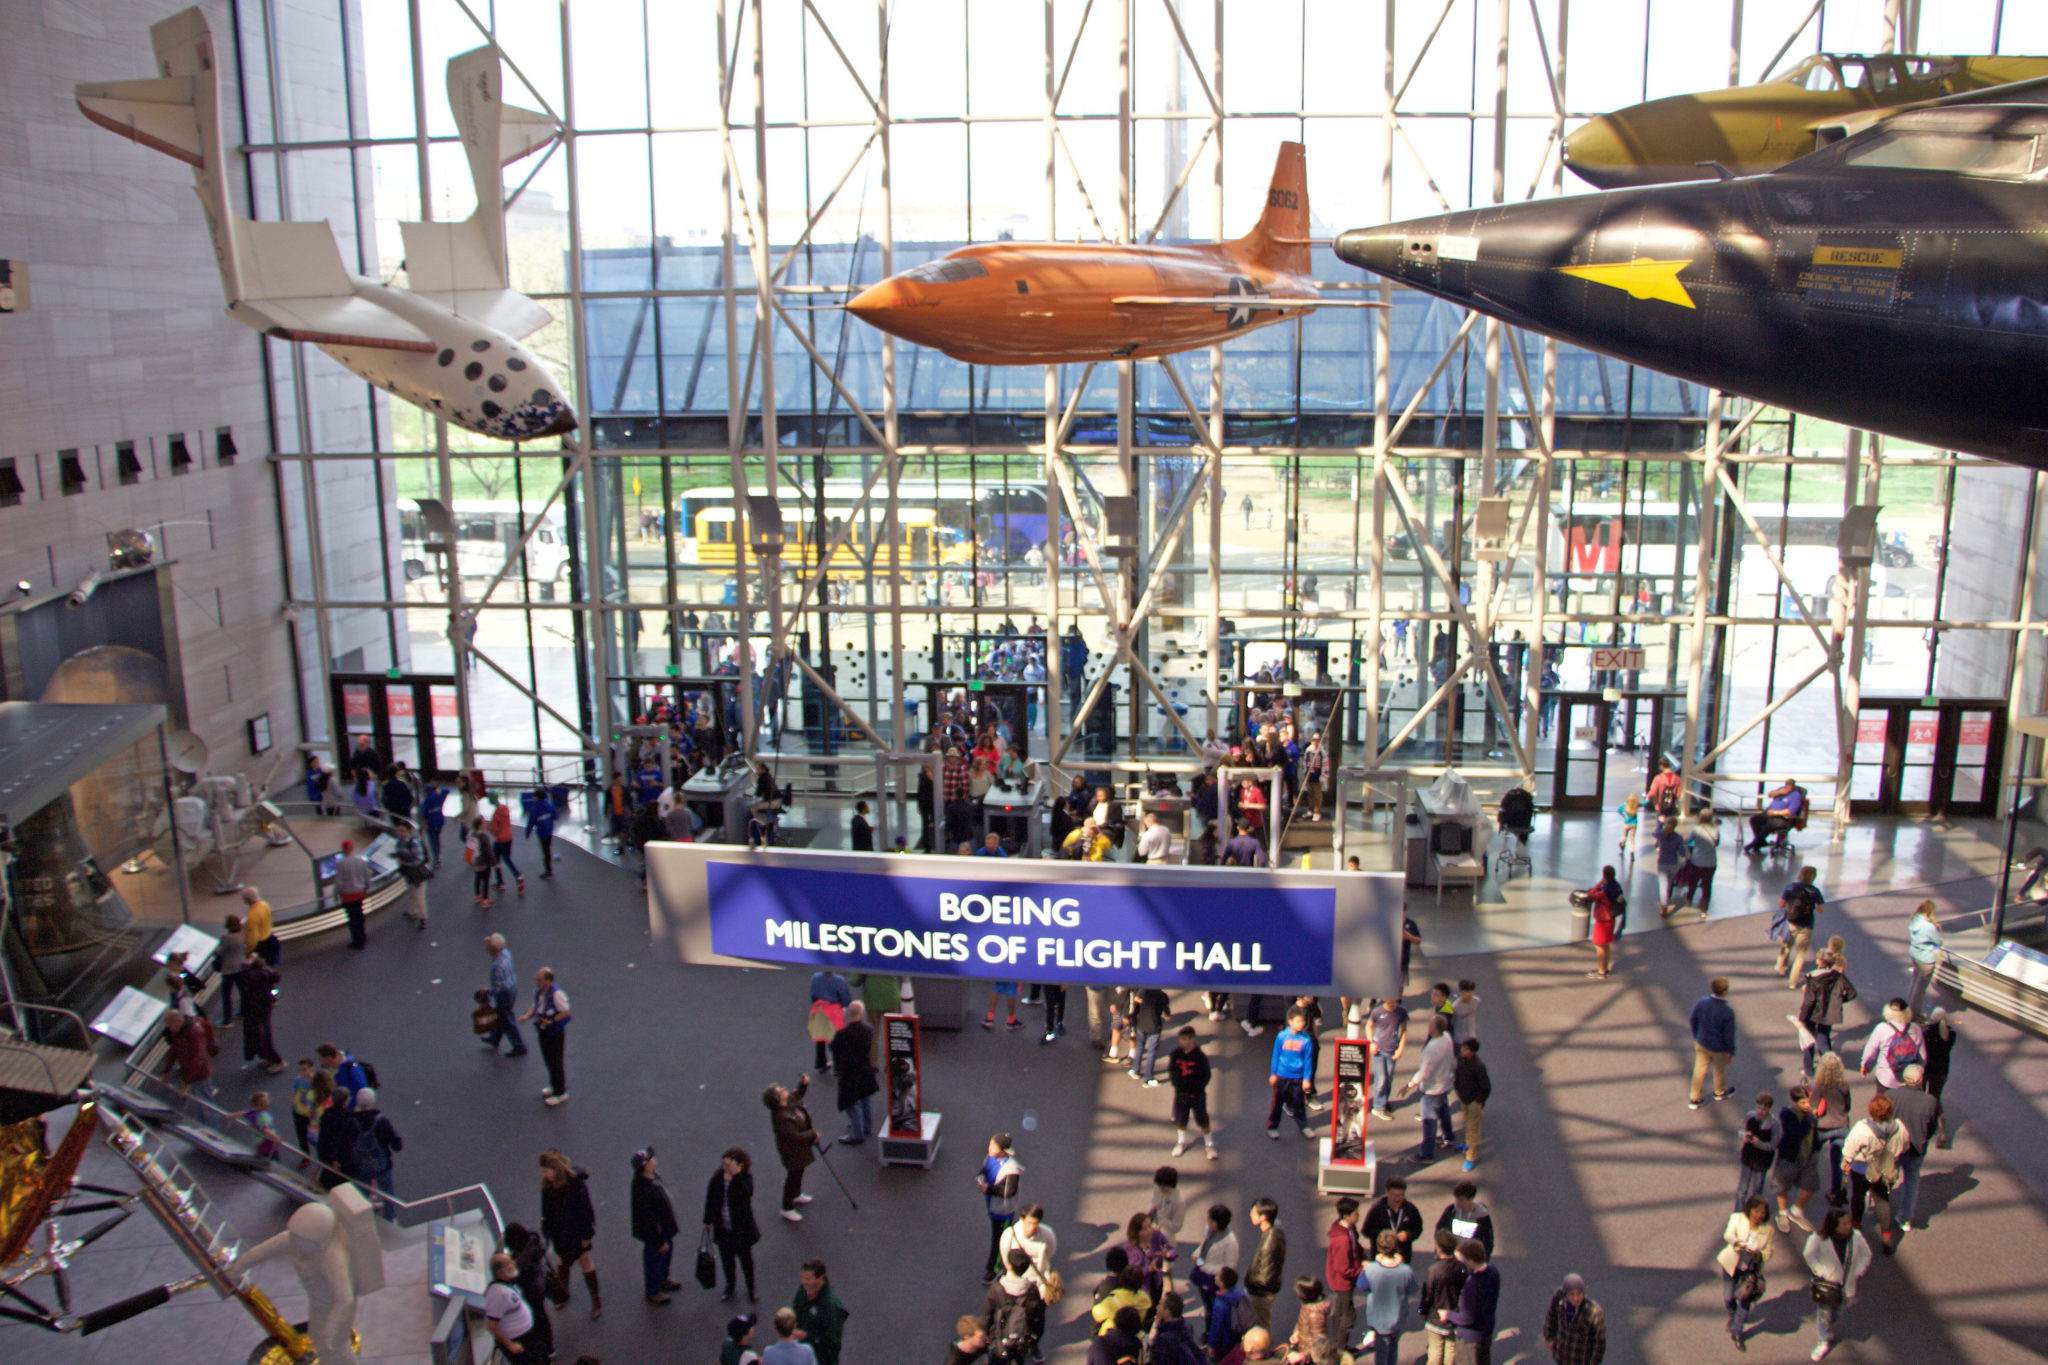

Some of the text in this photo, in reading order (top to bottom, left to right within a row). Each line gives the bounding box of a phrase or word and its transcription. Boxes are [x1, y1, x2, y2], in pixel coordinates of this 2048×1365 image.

[1268, 188, 1299, 210] 6062
[1830, 250, 1886, 264] RESCUE
[1594, 650, 1643, 668] EXIT
[938, 892, 1080, 928] BOEING
[765, 918, 1272, 971] MILESTONES OF FLIGHT HALL
